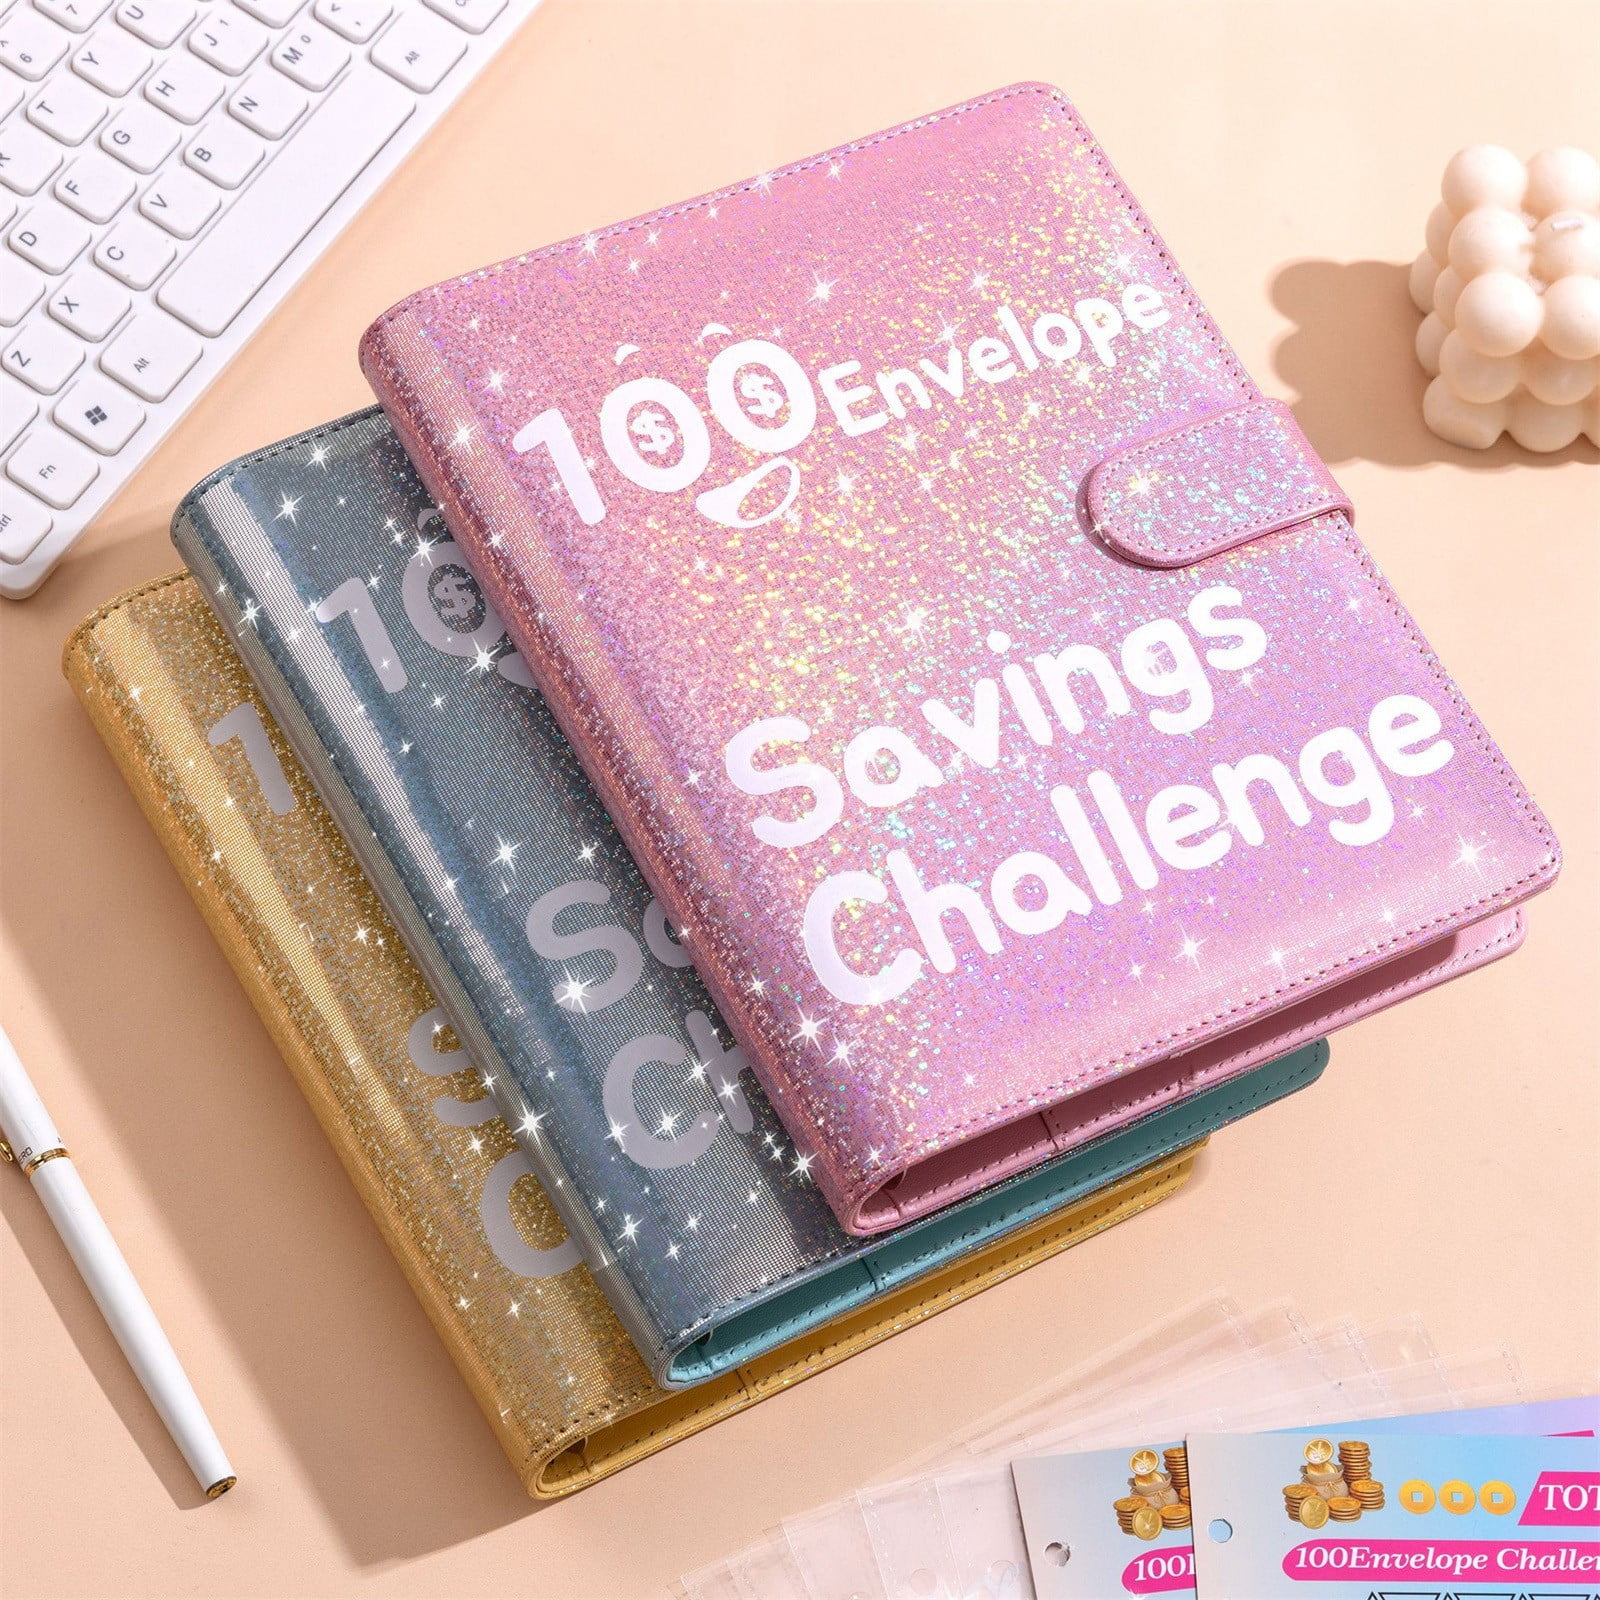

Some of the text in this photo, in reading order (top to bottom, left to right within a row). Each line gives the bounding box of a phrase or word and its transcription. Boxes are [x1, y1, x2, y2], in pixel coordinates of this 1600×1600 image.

[125, 5, 144, 21] U
[204, 33, 218, 47] J
[81, 51, 100, 66] Y
[282, 46, 304, 65] M
[404, 50, 420, 65] Alt
[155, 80, 176, 97] H
[36, 100, 54, 115] T
[238, 96, 259, 112] N
[112, 130, 131, 145] G
[193, 147, 212, 162] B
[65, 180, 80, 196] F
[149, 194, 168, 210] V
[18, 231, 38, 247] D
[106, 245, 124, 261] C
[58, 296, 79, 313] X
[11, 350, 31, 367] Z
[133, 357, 150, 373] Alt
[818, 283, 1172, 437] Envelope
[38, 464, 57, 480] Fn
[725, 585, 1268, 848] Savings
[802, 694, 1456, 1004] Challenge
[1295, 1546, 1488, 1576] 100Envelope
